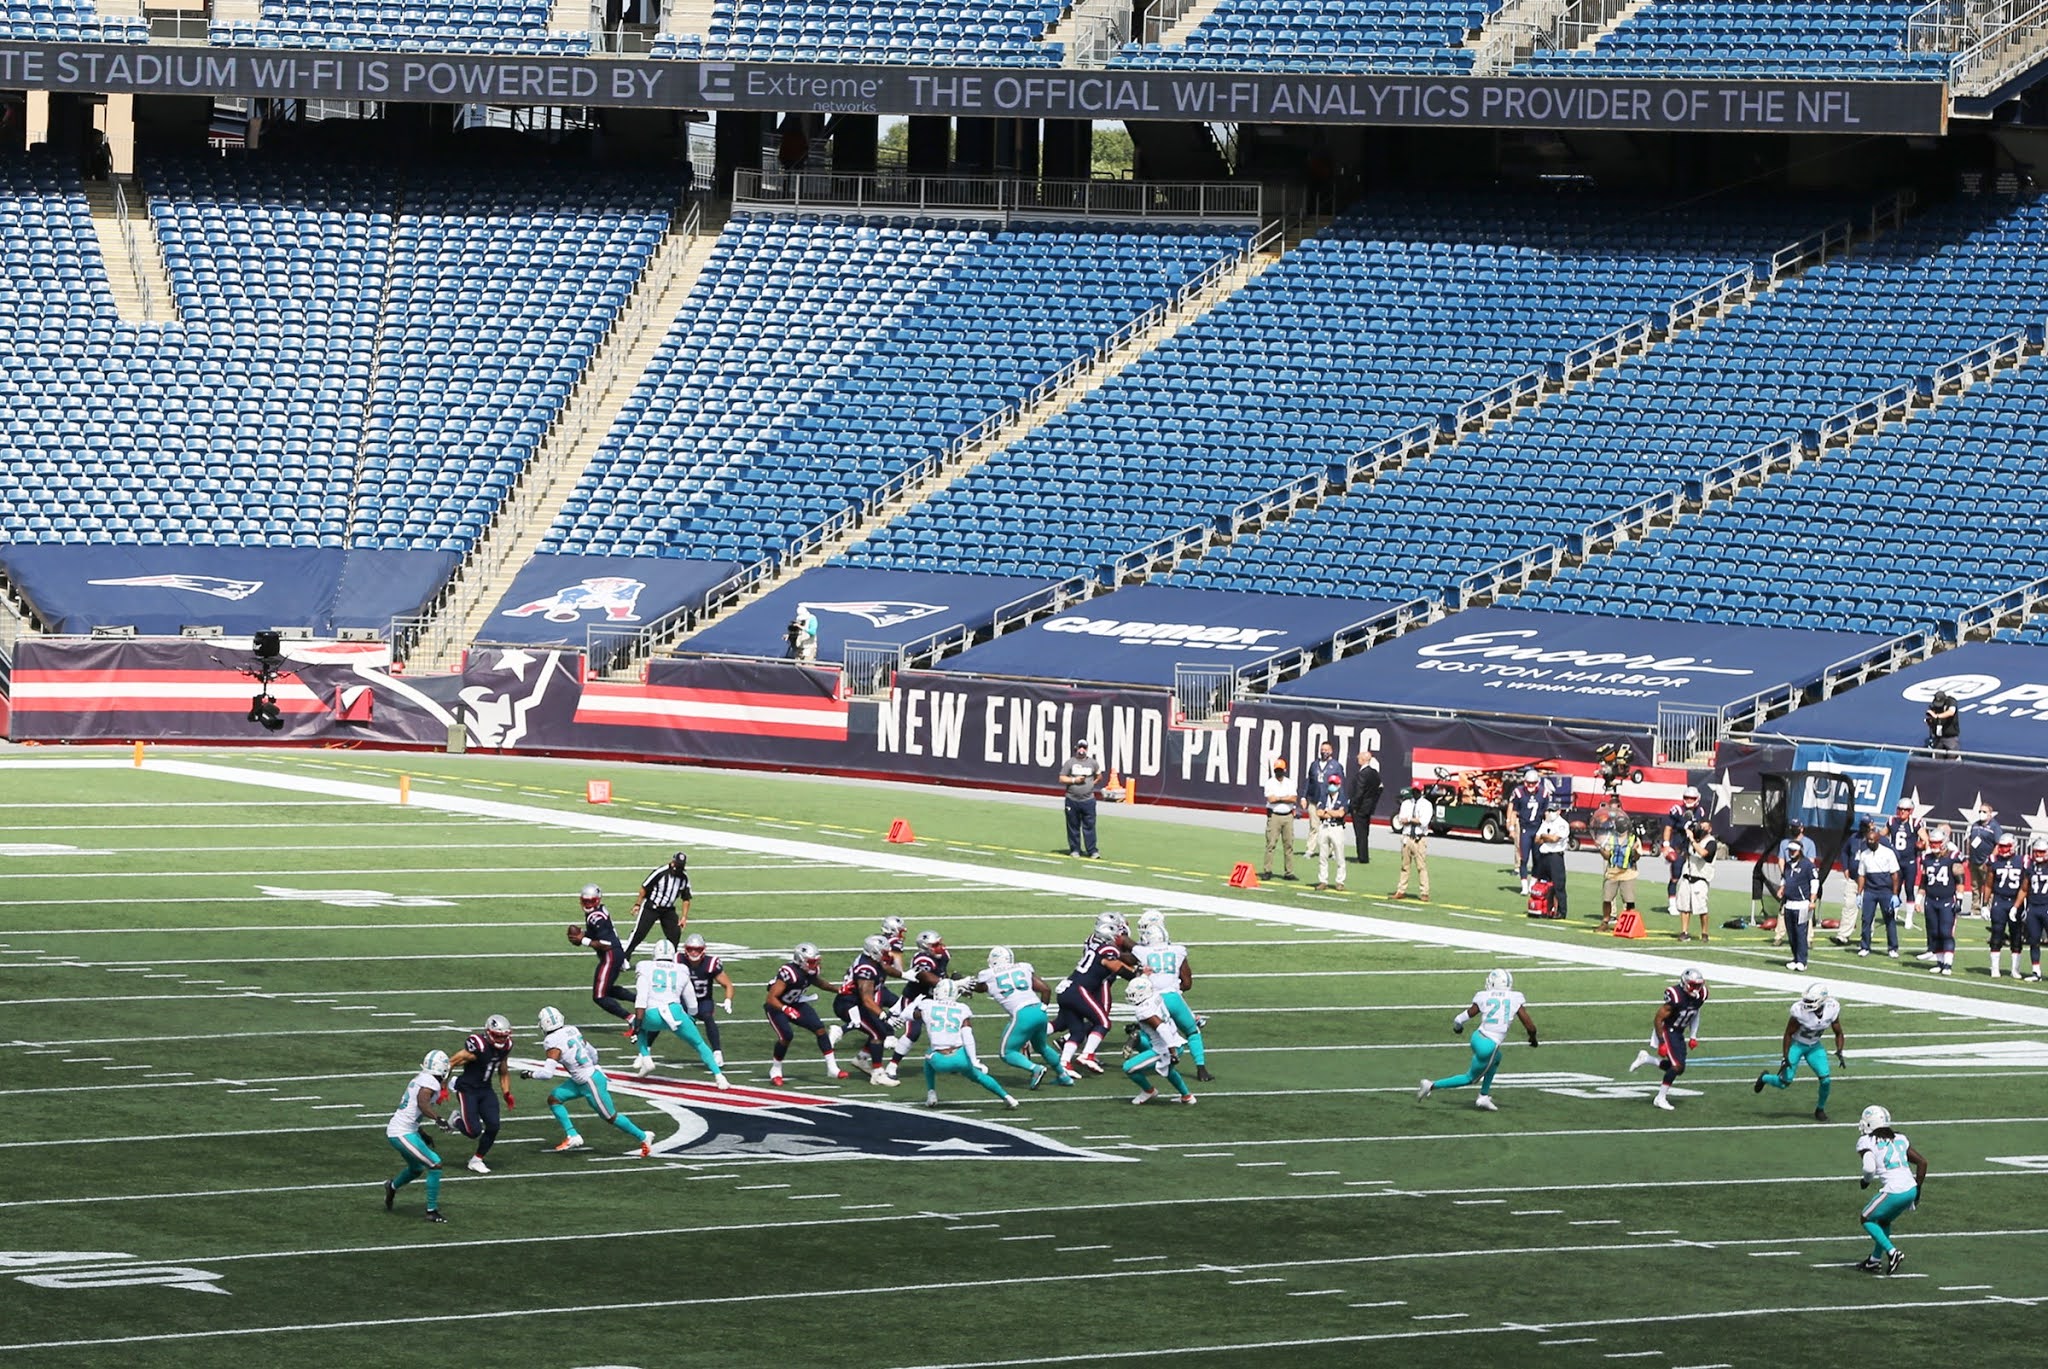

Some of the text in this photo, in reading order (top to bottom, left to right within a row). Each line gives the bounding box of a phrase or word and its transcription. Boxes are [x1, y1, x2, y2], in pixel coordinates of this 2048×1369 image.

[57, 51, 236, 88] STADIUM
[250, 58, 343, 90] WI-FI
[357, 61, 389, 92] IS
[403, 62, 597, 98] POWERED
[611, 69, 663, 99] BY
[748, 71, 877, 97] Extreme
[813, 100, 877, 112] networks
[908, 76, 1860, 124] THE OFFICIAL WI-FI ANALYTICS PROVIDER OF THE NFL
[1418, 630, 1754, 674] Encore
[1416, 660, 1690, 688] BOSTON HARBOR
[1484, 680, 1660, 698] A WYNN RESORT
[877, 687, 966, 759] NEW
[986, 696, 1163, 777] ENGLAND
[1527, 801, 1539, 821] 7
[889, 820, 903, 839] 10
[1895, 831, 1907, 850] 6
[1230, 864, 1248, 884] 20
[1996, 868, 2021, 889] 75
[1616, 914, 1636, 933] 30
[652, 969, 677, 993] 91
[996, 970, 1028, 997] 56
[930, 1006, 961, 1033] 55
[1486, 998, 1510, 1024] 21
